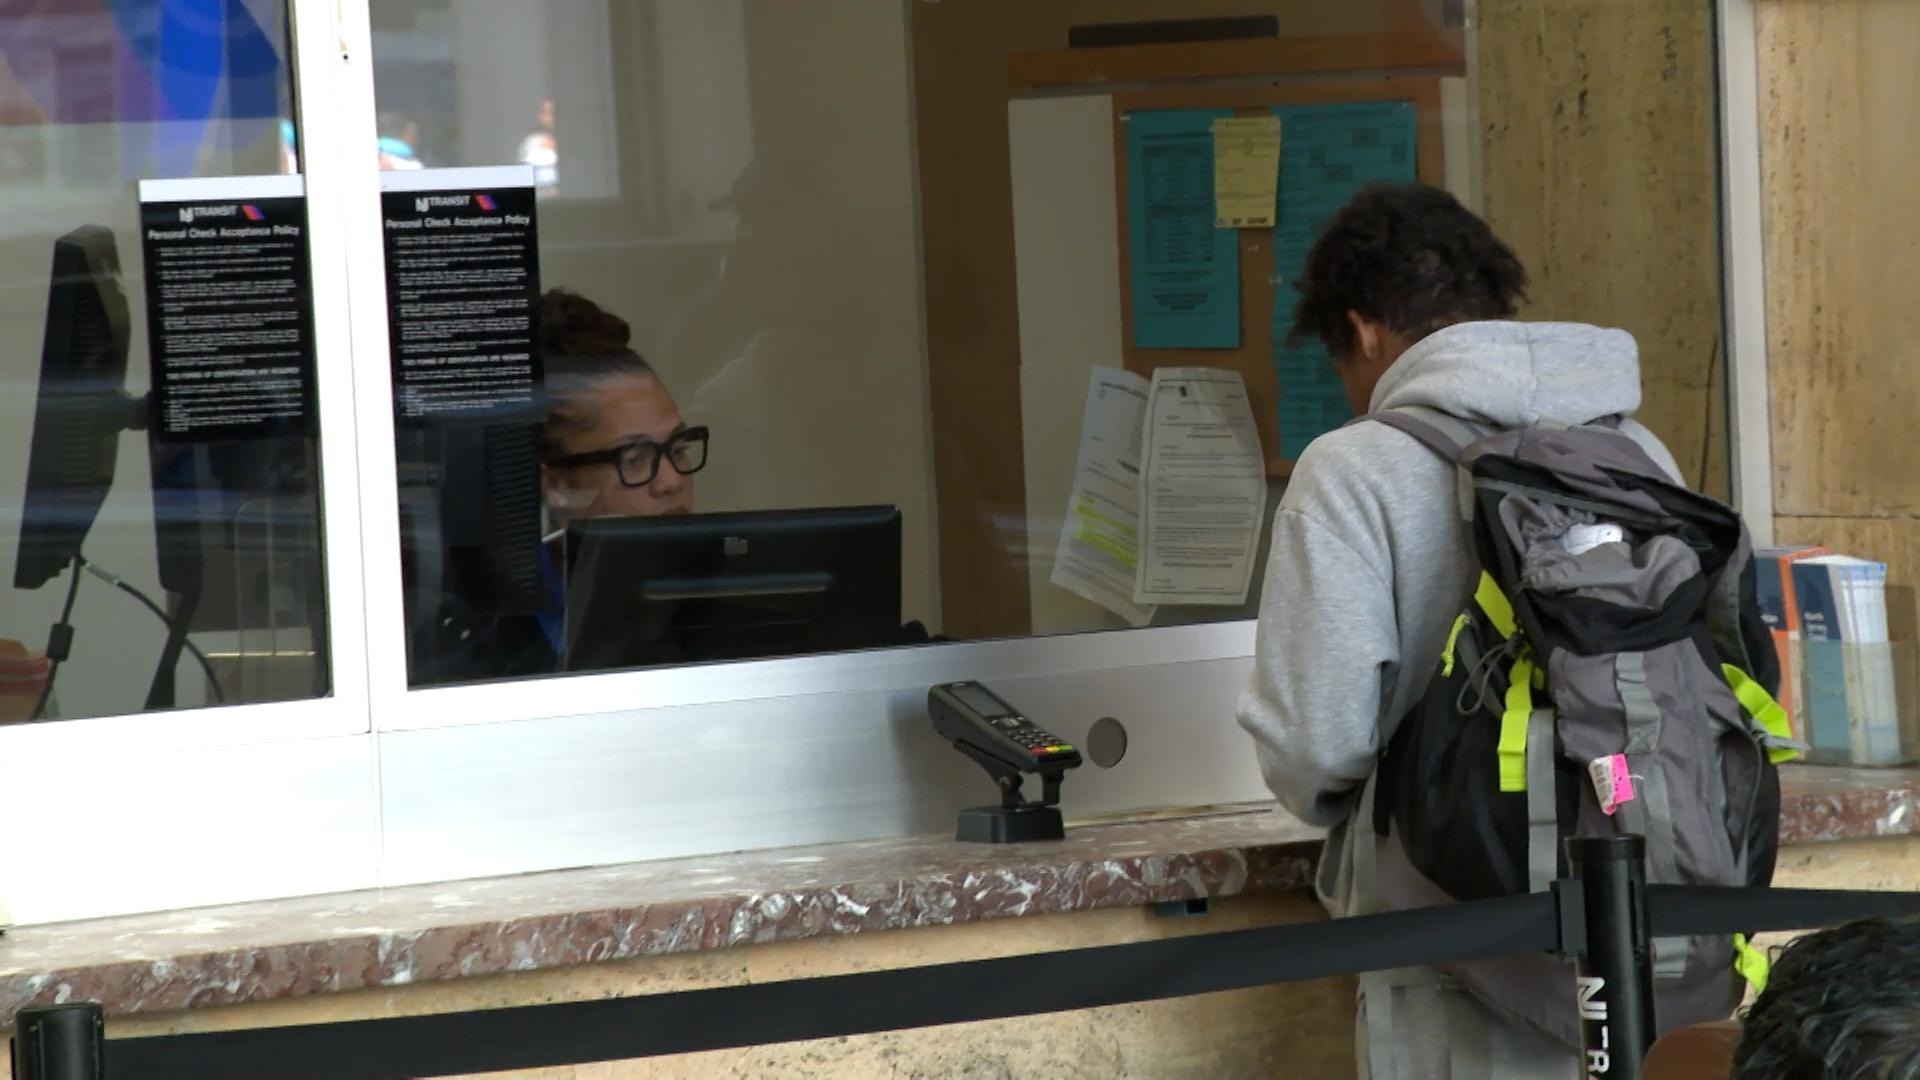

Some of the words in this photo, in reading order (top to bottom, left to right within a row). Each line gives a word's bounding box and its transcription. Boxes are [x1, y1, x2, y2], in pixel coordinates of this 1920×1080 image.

[385, 219, 422, 229] Personal
[424, 217, 451, 228] Check
[454, 216, 503, 228] Acceptance
[505, 215, 530, 226] Policy
[148, 229, 187, 240] Personal
[188, 227, 217, 238] Check
[219, 226, 271, 238] Acceptance
[272, 224, 299, 236] Policy
